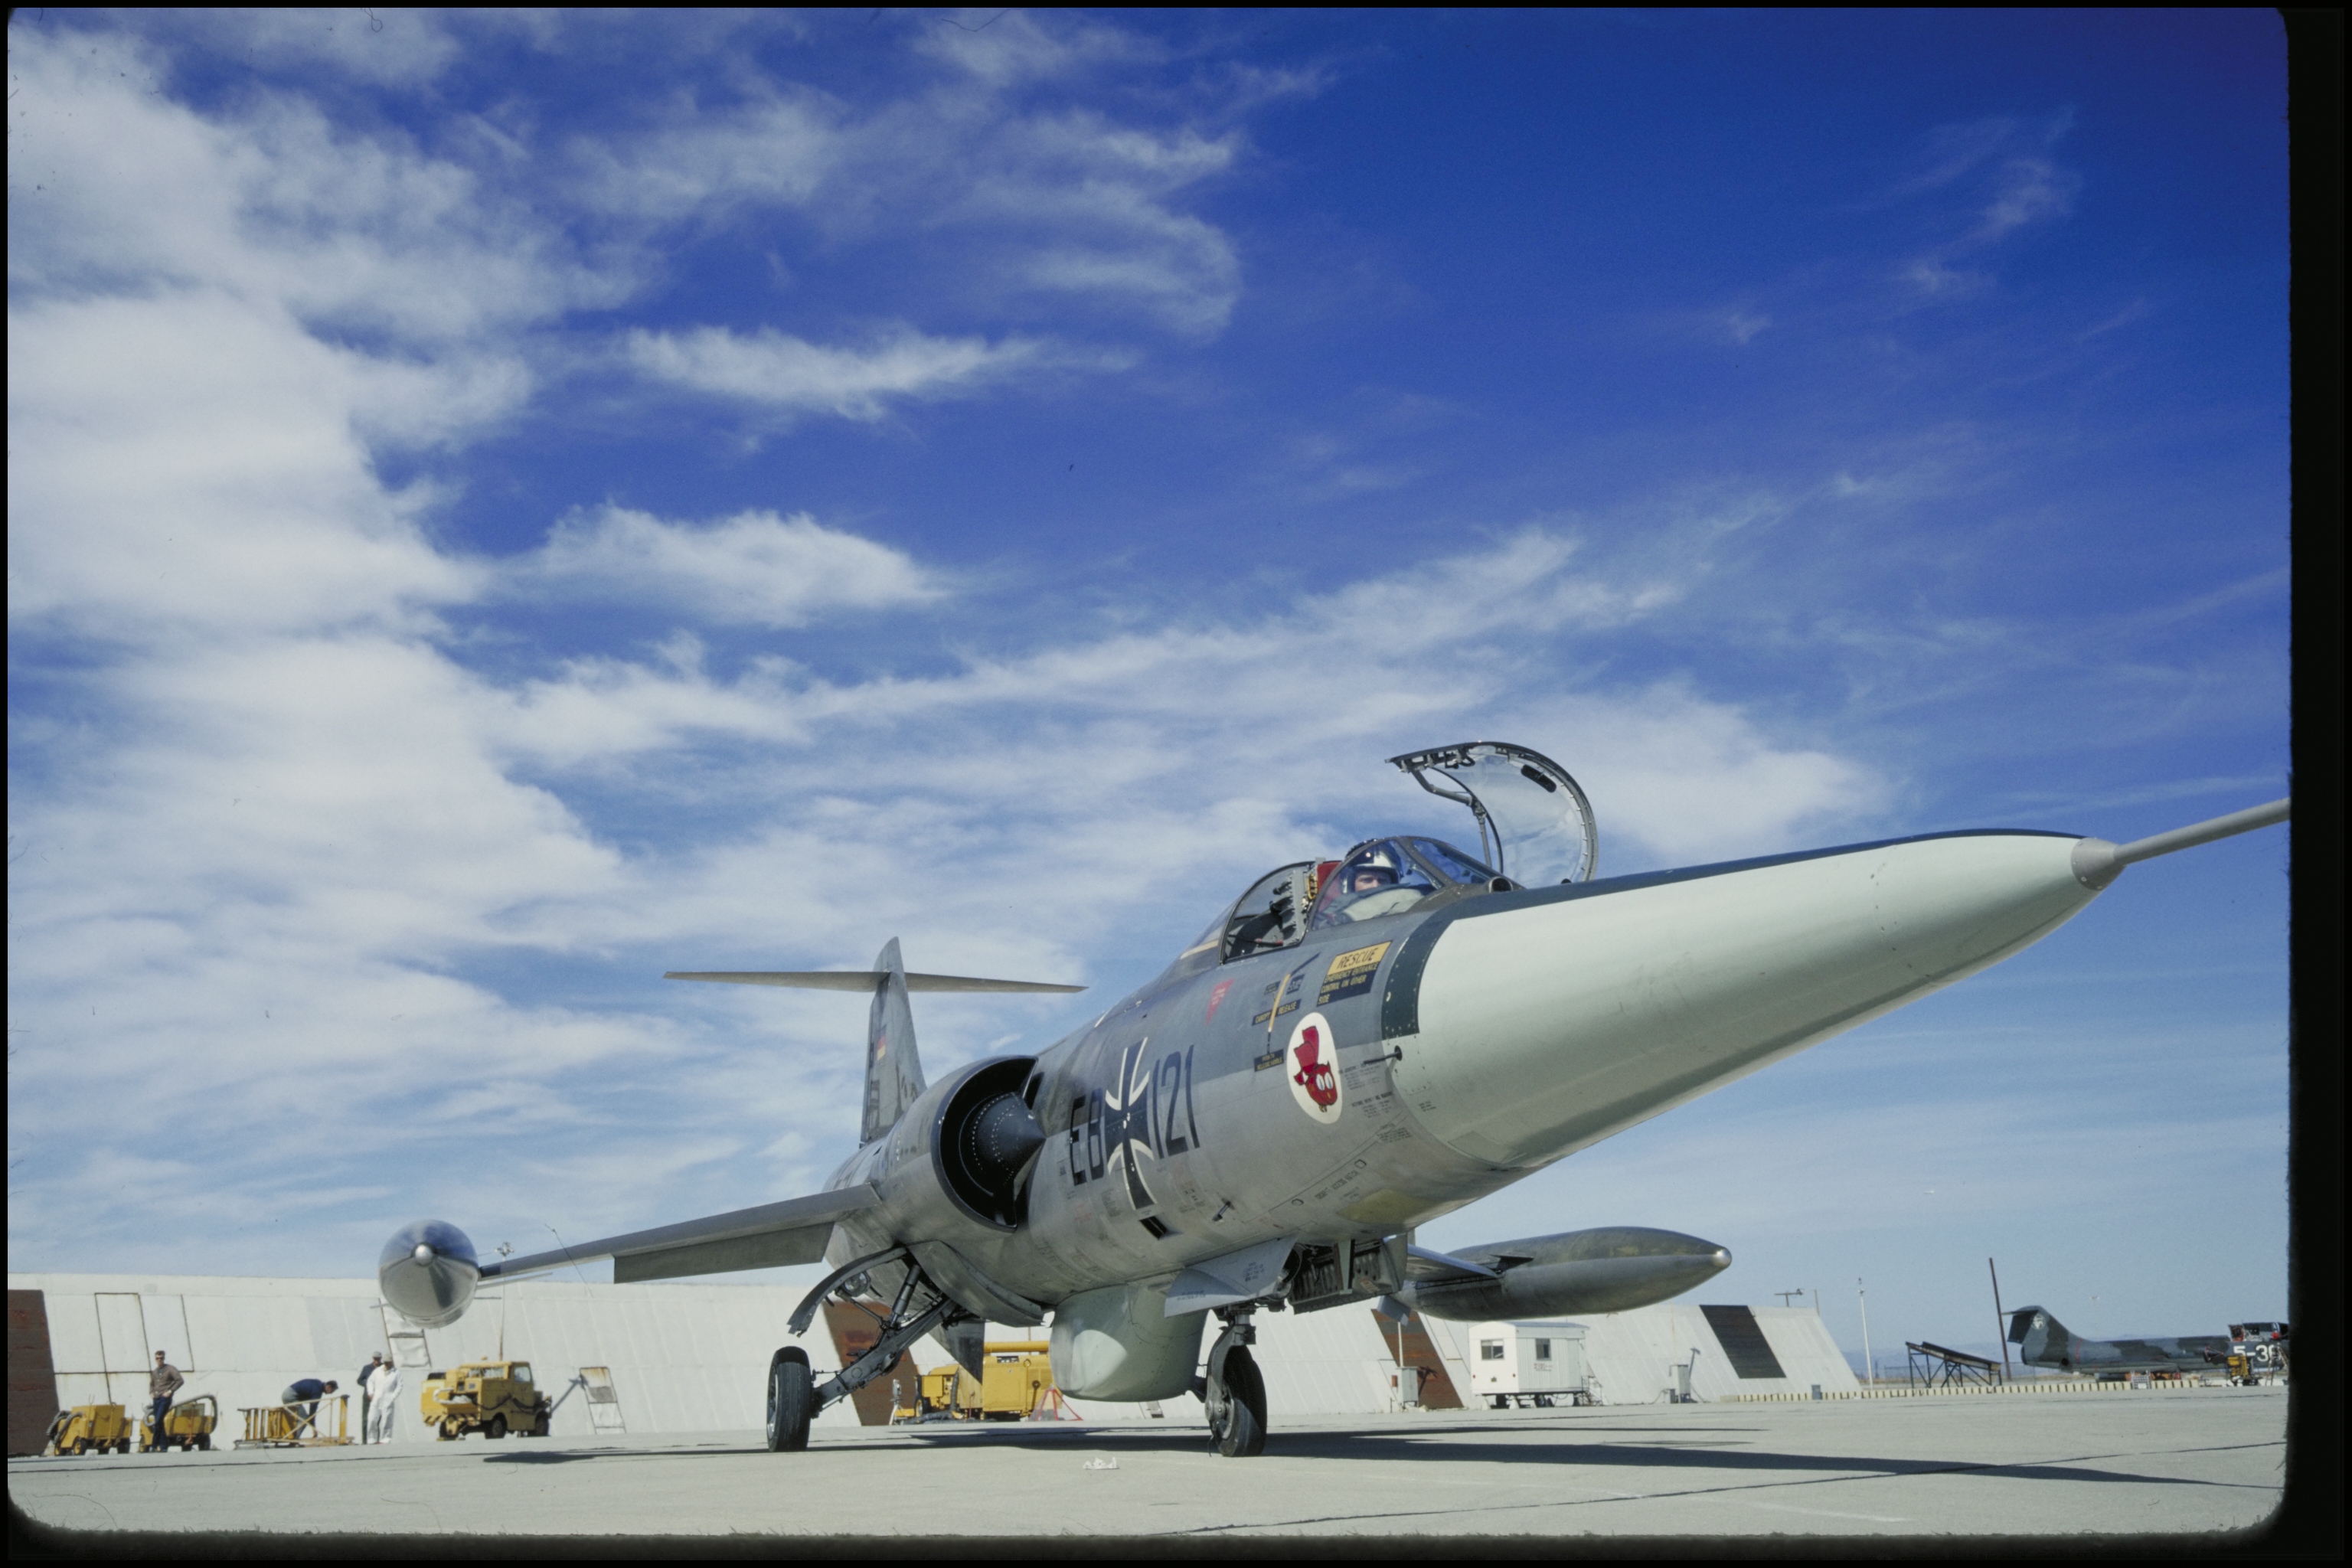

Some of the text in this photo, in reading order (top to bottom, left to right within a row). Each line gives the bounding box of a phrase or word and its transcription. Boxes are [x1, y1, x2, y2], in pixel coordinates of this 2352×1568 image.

[1337, 947, 1379, 970] RESCUE
[1321, 974, 1367, 994] CONTROL ON OTHER
[1324, 962, 1379, 985] EMERGENCY ENTRANCE
[1318, 994, 1331, 1005] SIDE
[1255, 1001, 1297, 1024] CANOPY RELEASE
[1152, 1044, 1200, 1160] 121
